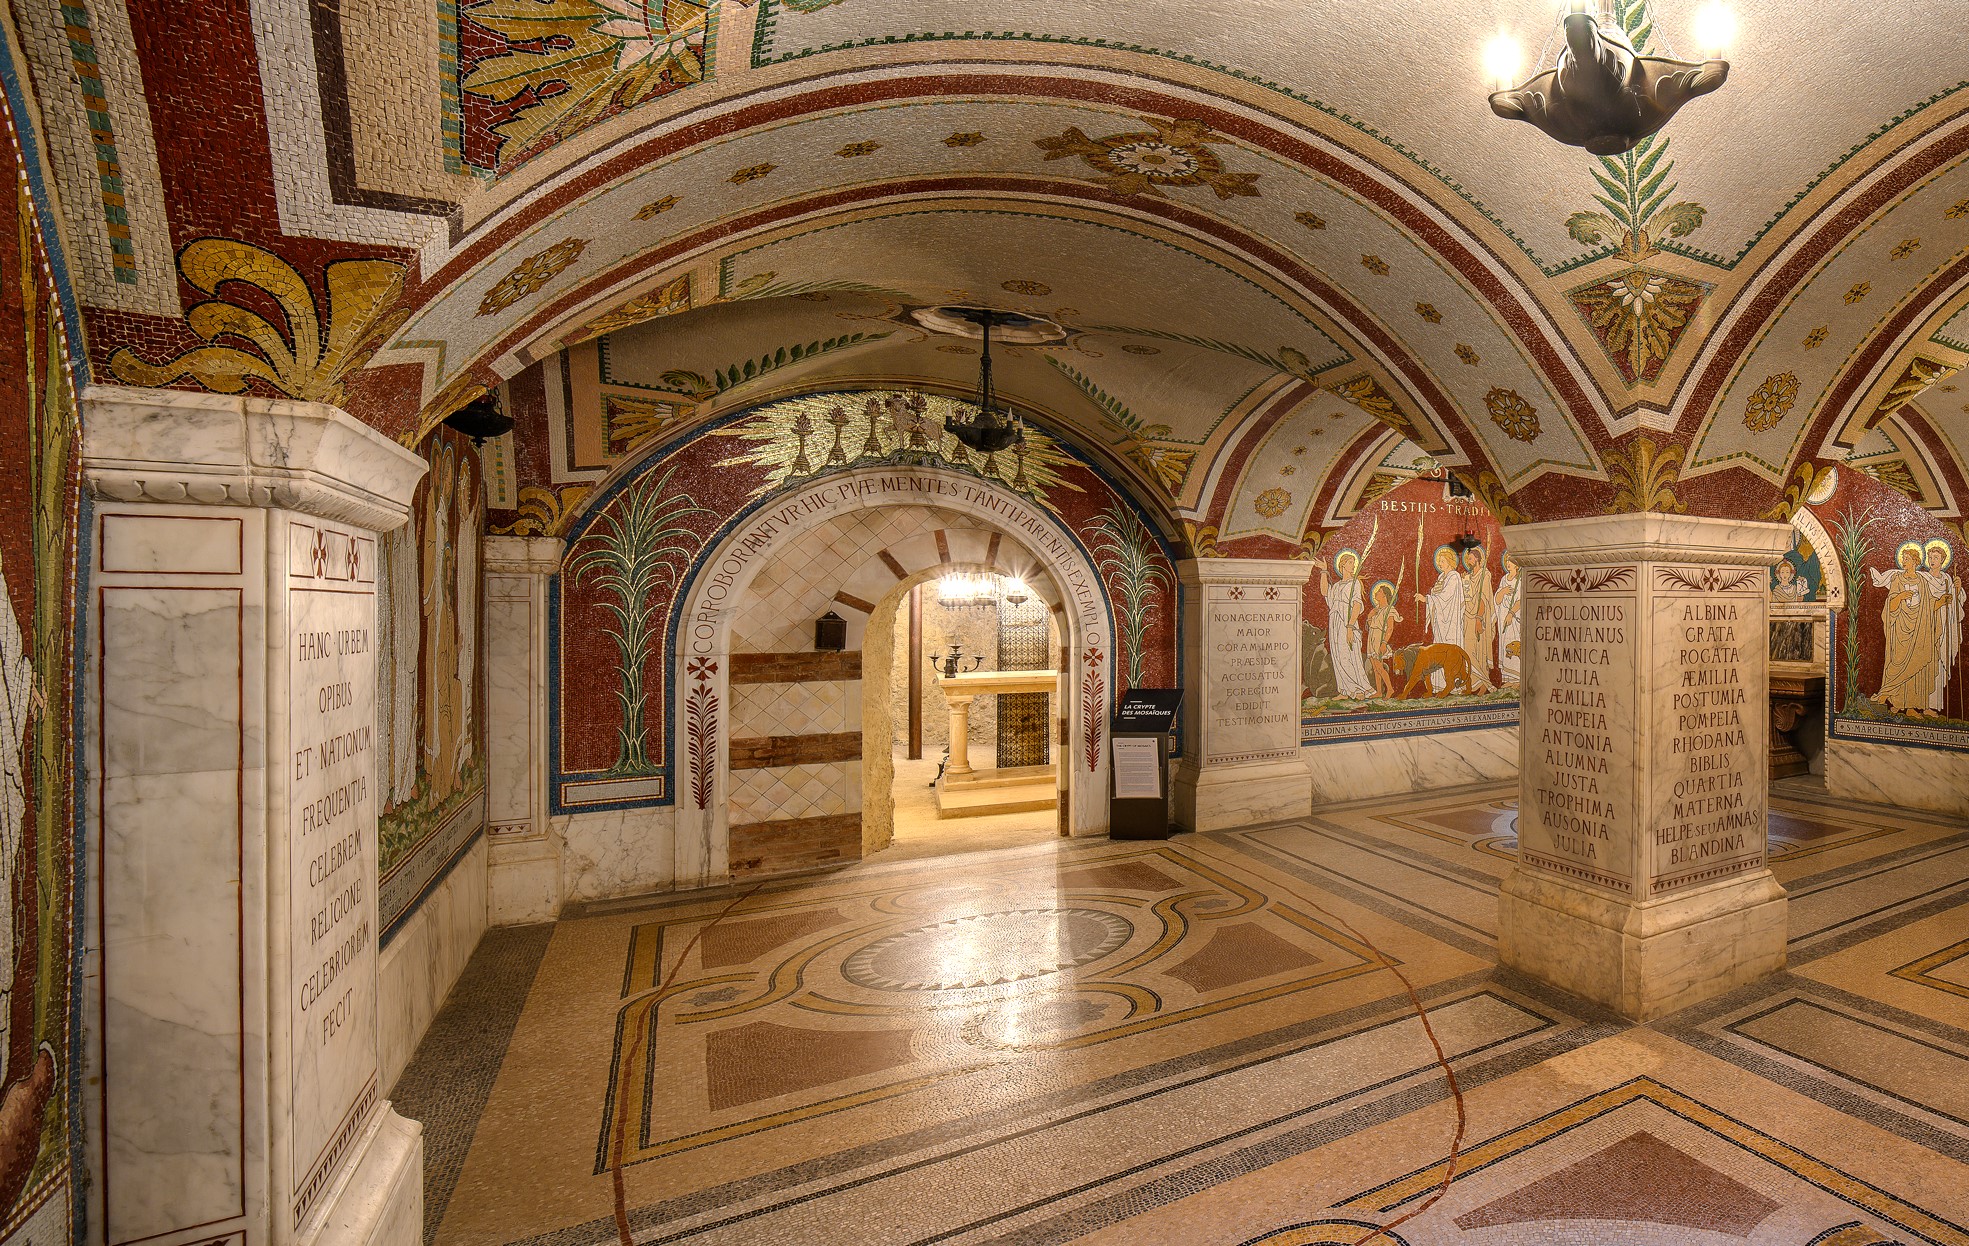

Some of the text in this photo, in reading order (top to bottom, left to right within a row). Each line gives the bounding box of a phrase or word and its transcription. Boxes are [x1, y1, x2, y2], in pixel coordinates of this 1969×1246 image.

[1381, 500, 1437, 513] BESTIIS
[800, 488, 838, 513] HIC
[881, 476, 958, 497] MENTES
[963, 485, 1018, 519] TANTI
[1067, 569, 1101, 646] EXEMPLO
[1535, 605, 1624, 621] APOLLONIUS
[1682, 604, 1738, 621] ALBINA
[1236, 628, 1271, 637] MAIOR
[1535, 626, 1624, 643] GEMINIANUS
[1685, 626, 1735, 642] GRATA
[298, 628, 369, 662] HANC URBEM
[1217, 642, 1290, 652] CORAM IMPIO
[1544, 646, 1610, 665] JAMNICA
[1680, 647, 1740, 665] ROGATA
[1221, 671, 1285, 682] ACCUSATUS
[1556, 668, 1600, 686] JULIA
[318, 681, 353, 714] OPIBUS
[1235, 700, 1271, 711] EDIDIT
[1673, 688, 1745, 710] POSTUMIA
[1215, 714, 1289, 728] TESTIMONIUM
[1547, 708, 1607, 730] POMPEIA
[1679, 709, 1740, 731] POMPEIA
[1541, 728, 1613, 753] ANTONIA
[1673, 729, 1745, 754] RHODANA
[296, 725, 371, 781] ET NATIONUM
[1545, 749, 1609, 774] ALUMNA
[1690, 752, 1730, 773] BIBLIS
[1553, 771, 1599, 795] JUSTA
[1673, 771, 1743, 799] QUARTIA
[303, 775, 367, 836] FREQUENTIA
[1537, 788, 1615, 820] TROPHIMA
[1673, 792, 1744, 820] MATERNA
[1543, 811, 1609, 841] AUSONIA
[309, 828, 362, 888] CELEBREM
[1553, 834, 1597, 860] JULIA
[1671, 833, 1745, 865] BLANDINA
[311, 877, 362, 946] RELIGIONE
[300, 920, 370, 1013] CELEBRIOREM
[323, 987, 353, 1046] FECIT
